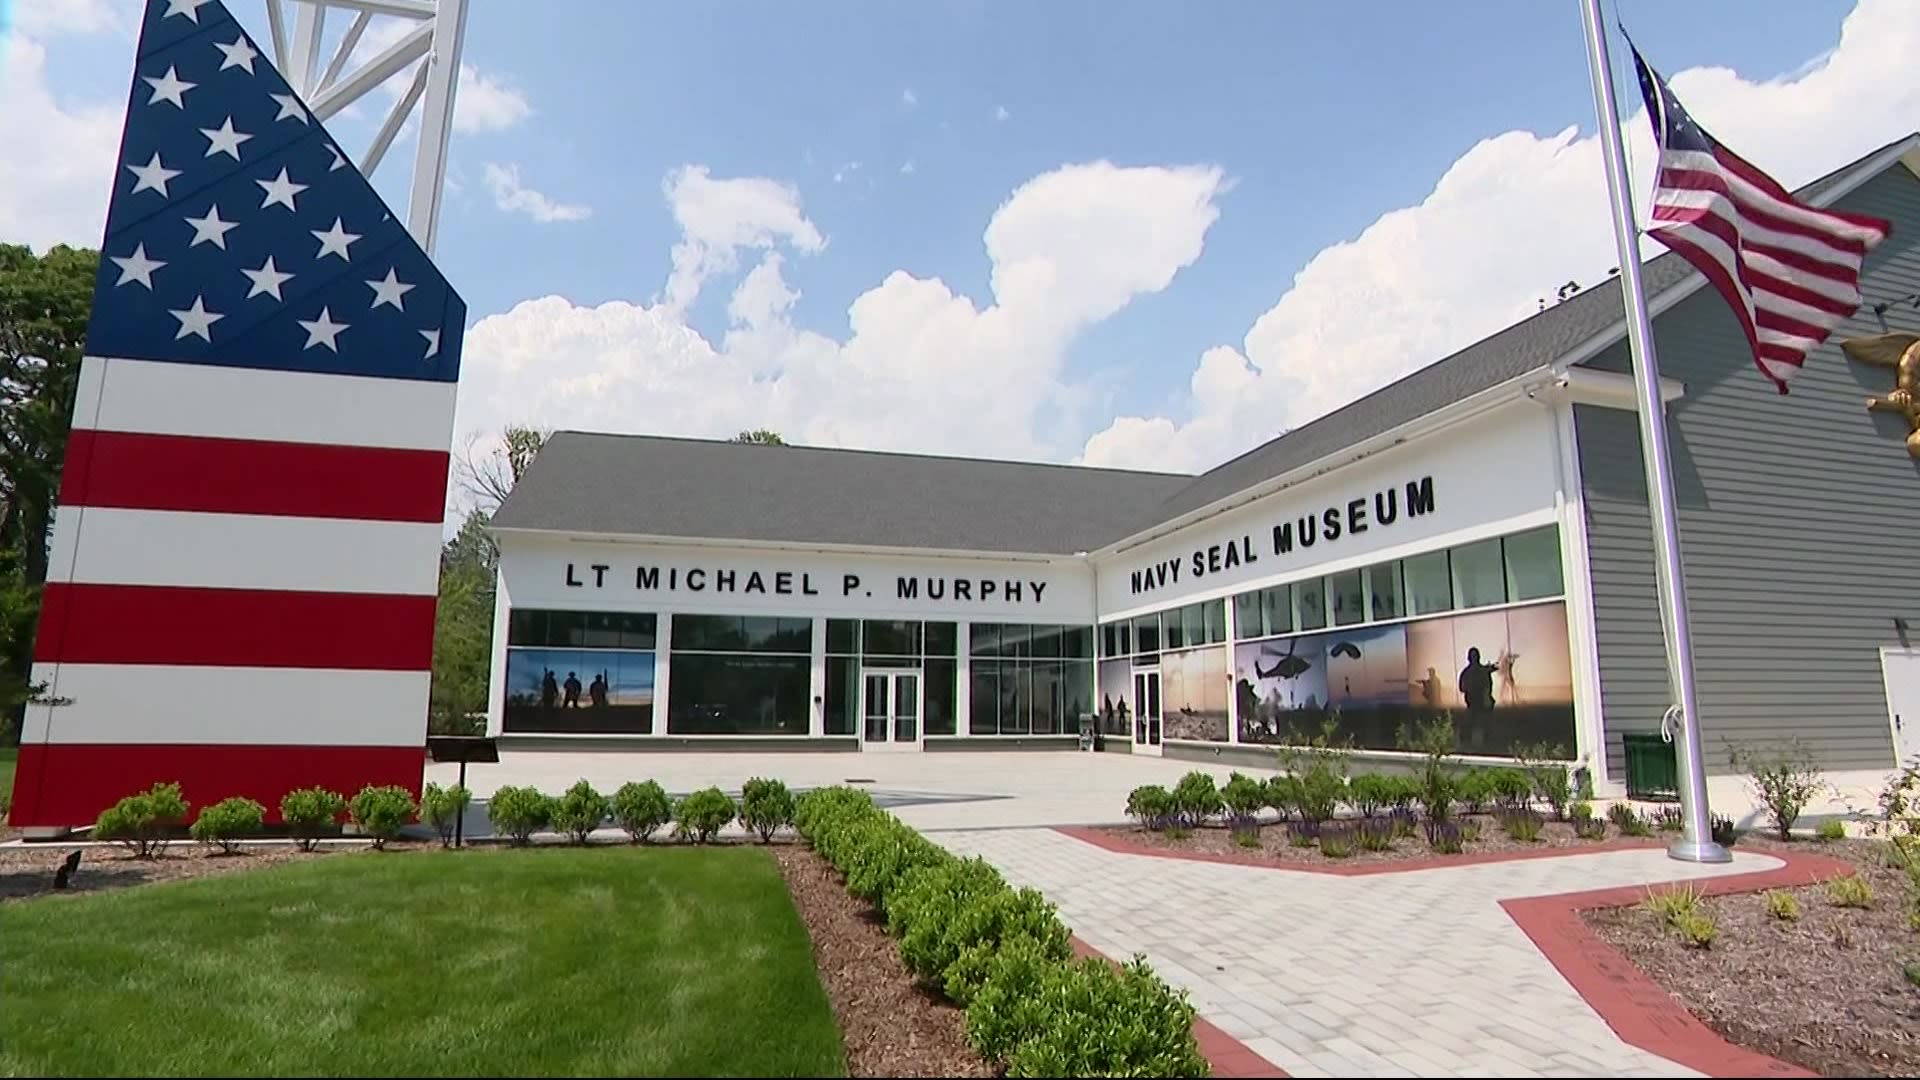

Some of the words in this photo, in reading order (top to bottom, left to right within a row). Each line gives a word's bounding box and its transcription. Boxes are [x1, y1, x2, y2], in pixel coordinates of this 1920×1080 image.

[1131, 558, 1181, 594] NAVY
[1192, 535, 1258, 577] SEAL
[1273, 476, 1435, 555] MUSEUM
[566, 563, 610, 588] LT
[635, 566, 819, 596] MICHAEL
[843, 574, 872, 598] P.
[897, 576, 1047, 603] MURPHY
